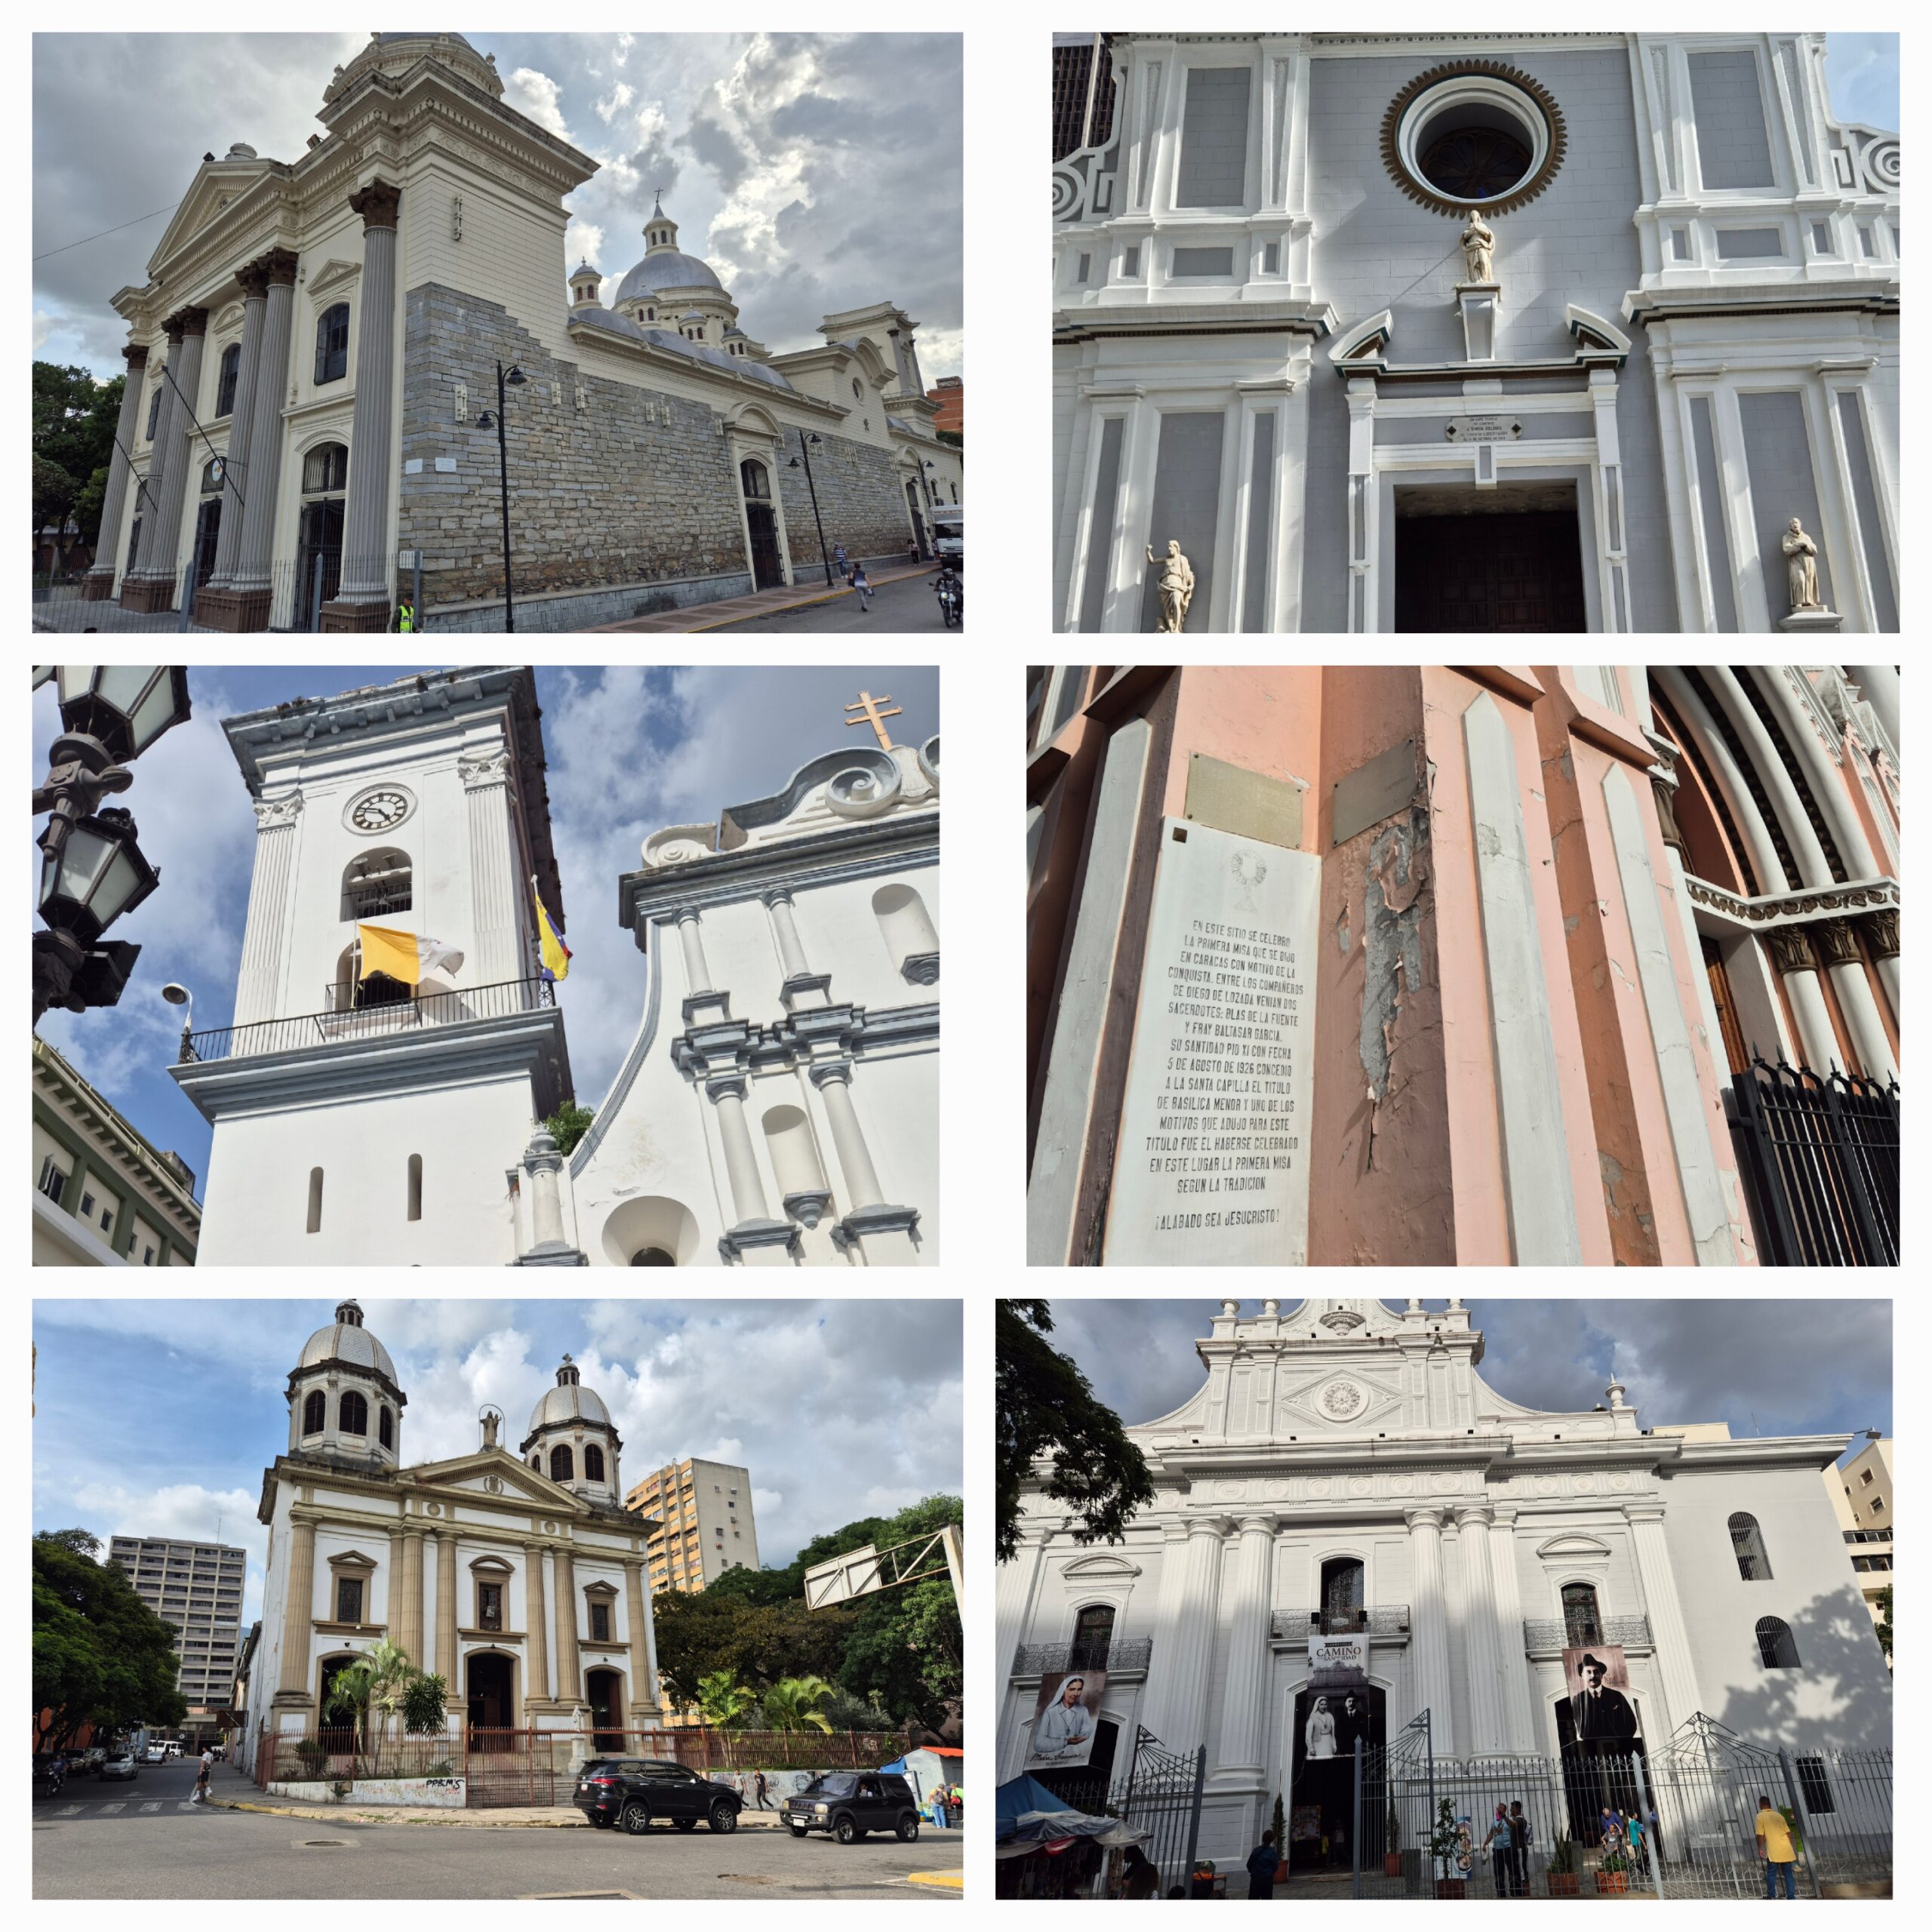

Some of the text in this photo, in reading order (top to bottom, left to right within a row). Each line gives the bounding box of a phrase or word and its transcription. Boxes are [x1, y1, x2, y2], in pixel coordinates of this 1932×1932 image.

[1193, 921, 1290, 947] EN ESTE SITIO SE CELEBRO
[1185, 935, 1294, 963] LA PRIMERA MISA QUE SE DIJO
[1180, 952, 1295, 978] EN CARACAS CON MOTIVO DE LA
[1217, 974, 1239, 986] ENTRE
[1243, 977, 1257, 989] LOS
[1260, 979, 1303, 995] COMPAÑEROS
[1174, 985, 1297, 1010] DE DIEGO DE LOZADA VENIAN DOS
[1168, 1002, 1298, 1026] SACERDOTES: BLAS DE LA FUENTE
[1185, 1022, 1189, 1033] Y
[1192, 1022, 1212, 1035] FRAY
[1215, 1025, 1251, 1039] BALTASAR
[1171, 1039, 1291, 1060] SU SANTIDAD PIO XI CON FECHA
[1168, 1058, 1291, 1076] 5 DE AGOSTO DE 1926 CONCEDIO
[1166, 1077, 1290, 1094] A LA SANTA CAPILLA EL TITULO
[1158, 1097, 1294, 1112] DE BASILICA MENOR Y UNO DE LOS
[1160, 1117, 1289, 1132] MOTIVOS QUE ADUJO PARA ESTE
[1146, 1137, 1298, 1151] TITULO FUE EL HABERSE CELEBRADO
[1150, 1156, 1291, 1172] EN ESTE LUGAR LA PRIMERA MISA
[1177, 1177, 1266, 1193] SEGUN LA TRADICION
[1205, 1213, 1221, 1227] SEA
[1226, 1209, 1279, 1226] JESUCRISTO!
[1316, 1647, 1361, 1657] CAMINO
